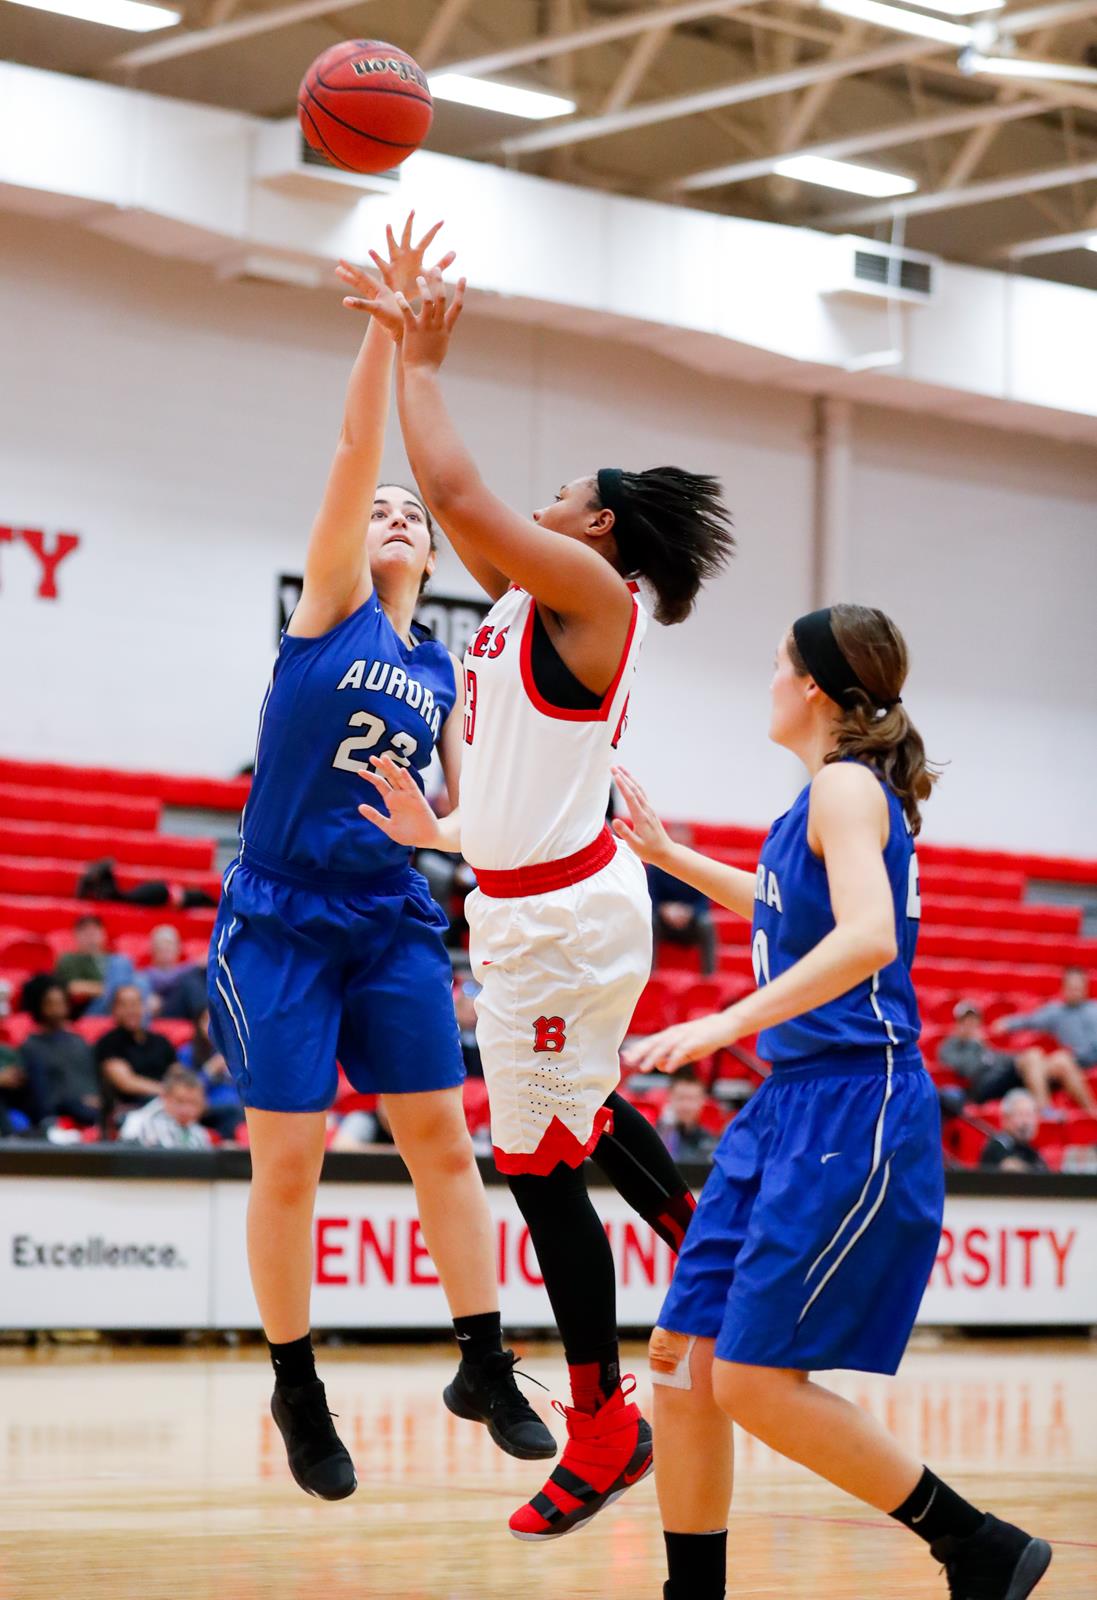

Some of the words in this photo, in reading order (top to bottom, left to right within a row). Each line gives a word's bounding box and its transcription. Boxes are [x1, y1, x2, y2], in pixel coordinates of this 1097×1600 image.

[336, 659, 441, 742] AURORA
[532, 1015, 567, 1053] B
[12, 1235, 187, 1268] Excellence.
